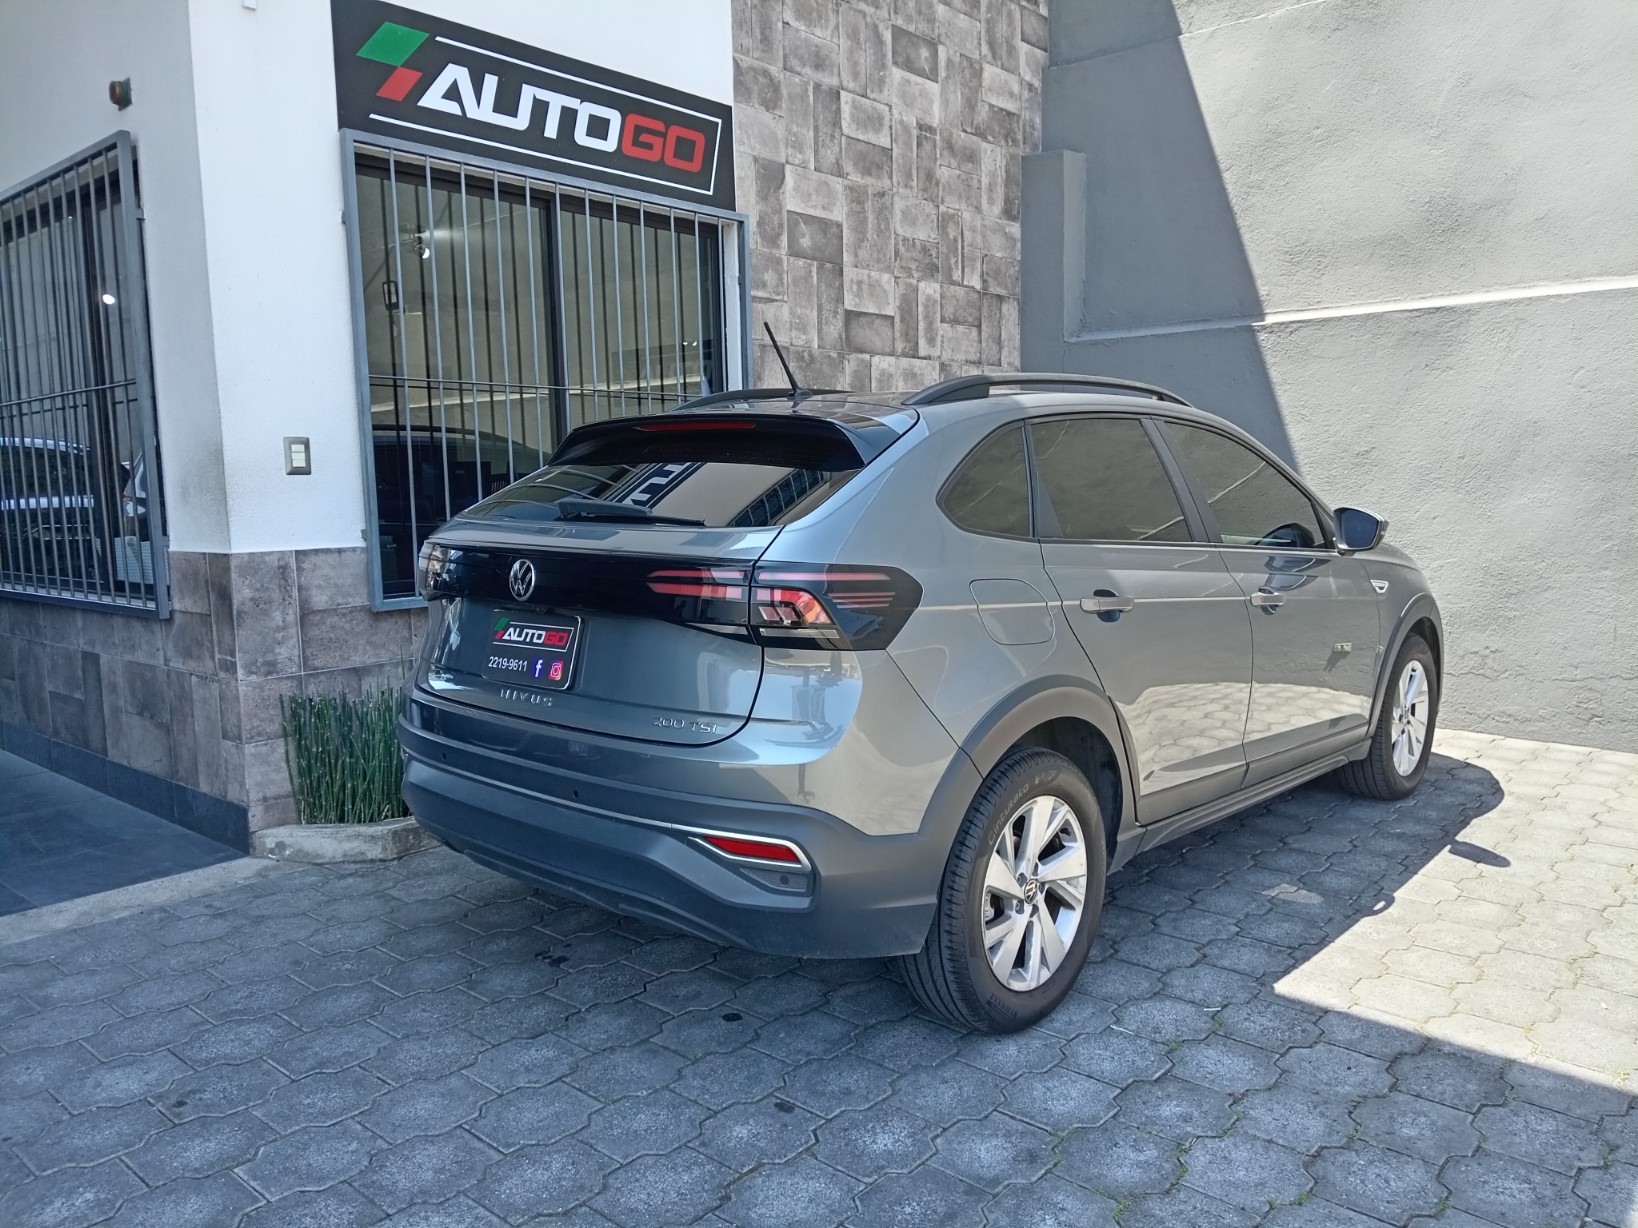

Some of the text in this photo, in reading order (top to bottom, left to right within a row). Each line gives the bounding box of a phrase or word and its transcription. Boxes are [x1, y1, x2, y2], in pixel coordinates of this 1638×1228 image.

[417, 63, 706, 173] AUTOGO
[502, 627, 569, 646] AUTOGO
[488, 656, 528, 672] 2219-9611
[652, 717, 717, 734] 200 TSI
